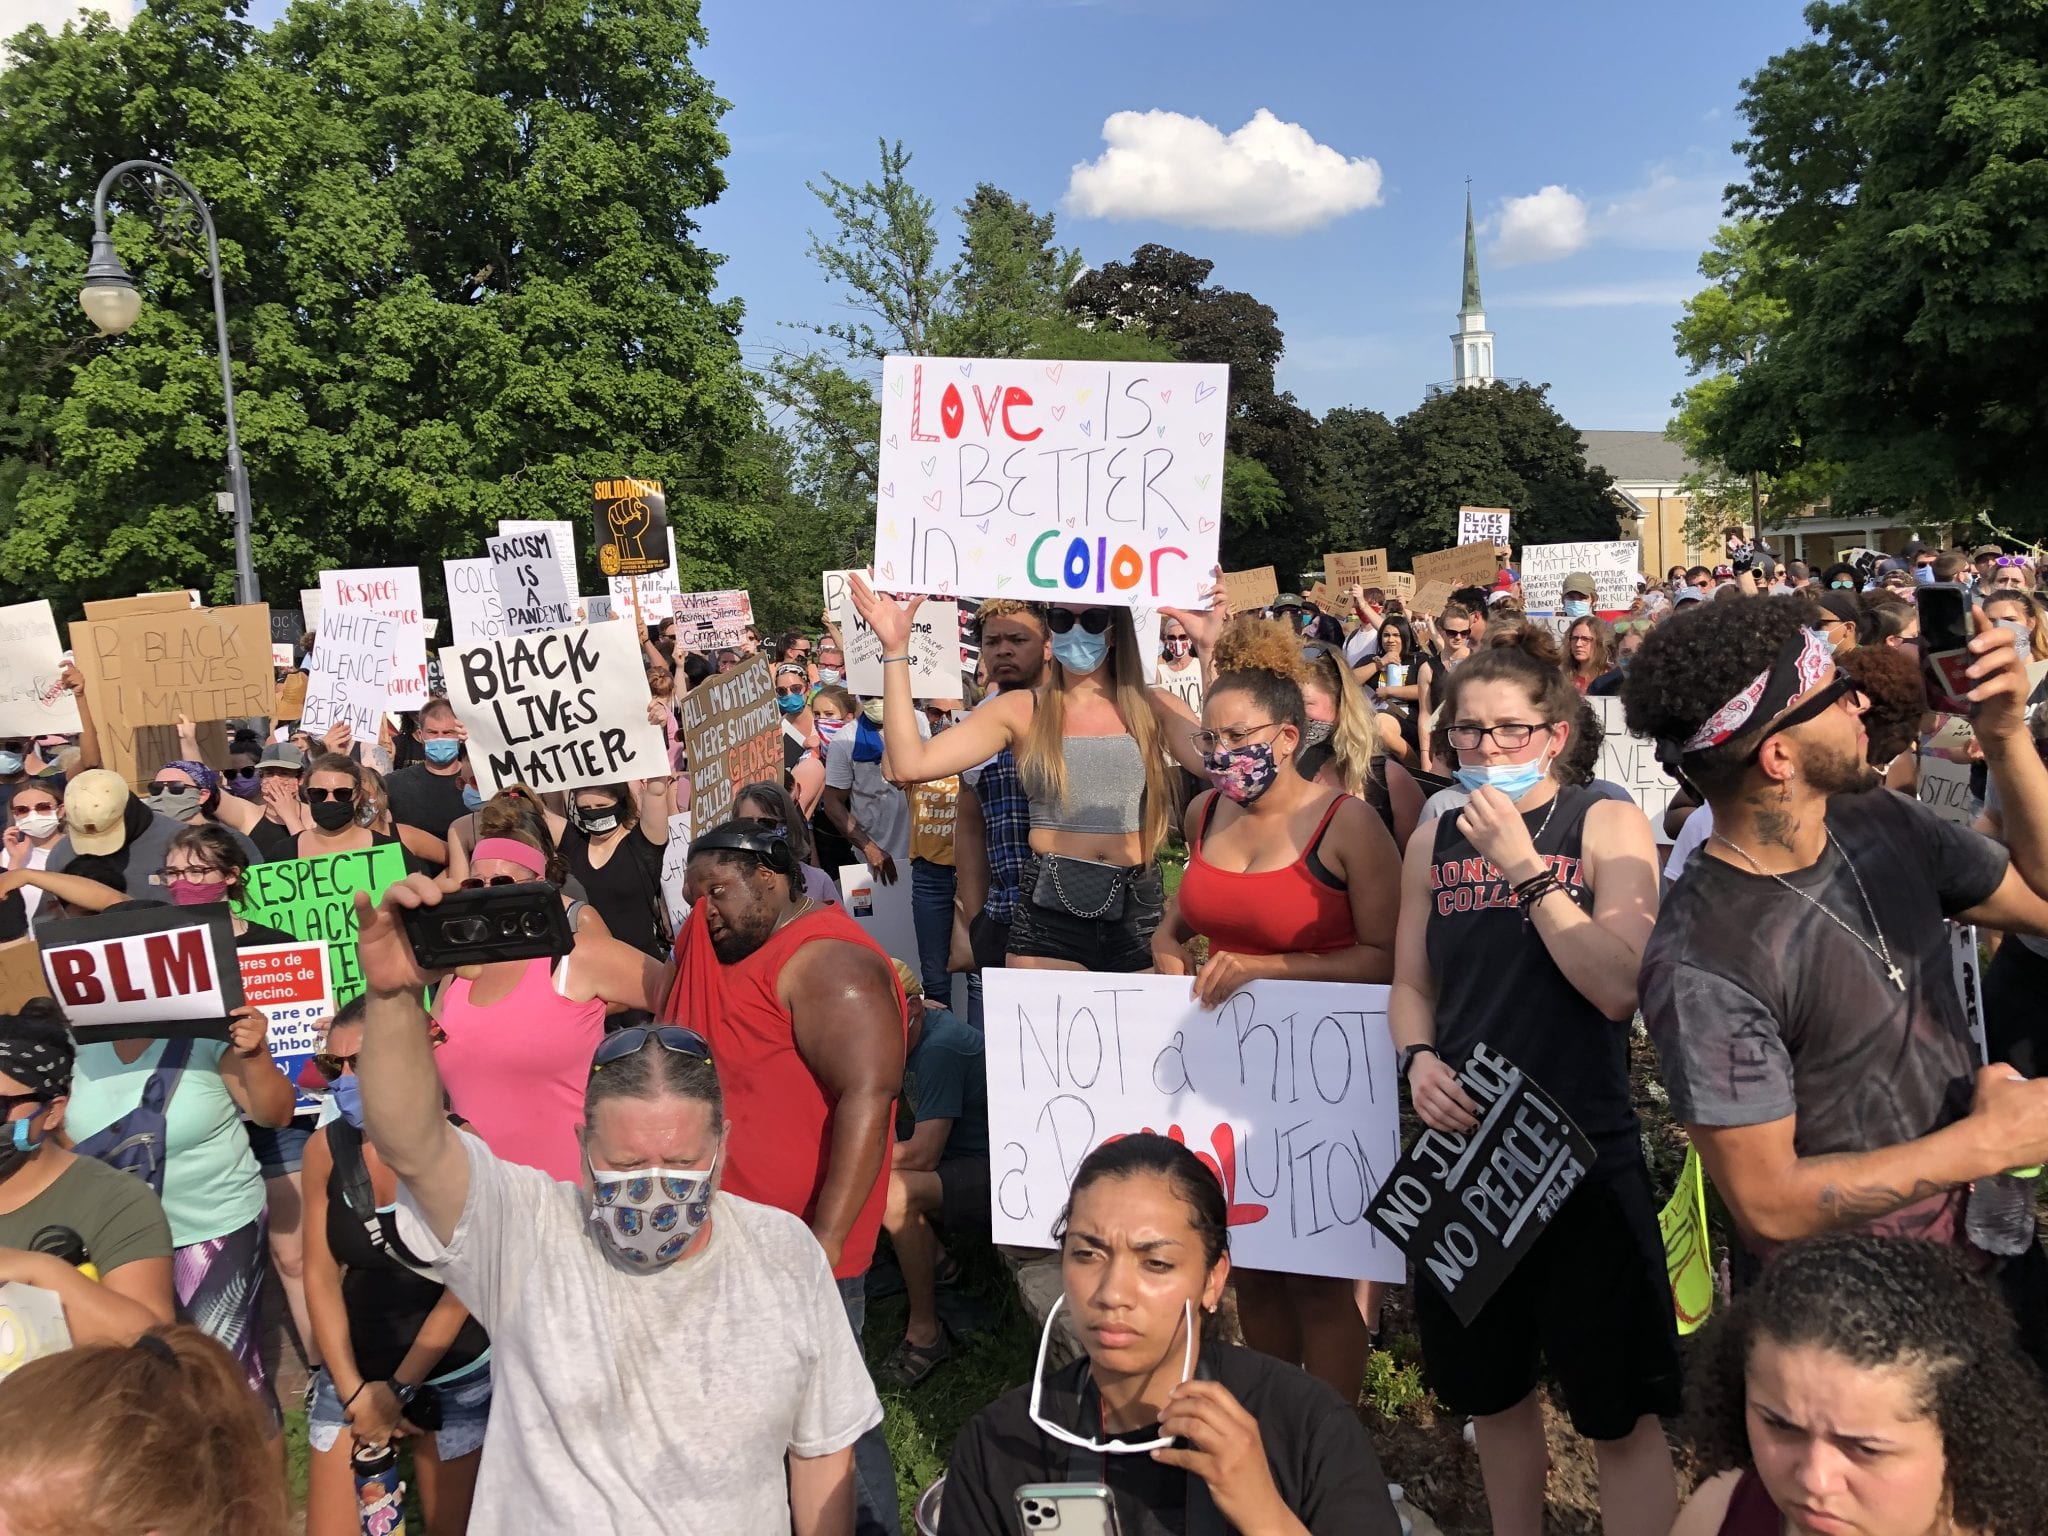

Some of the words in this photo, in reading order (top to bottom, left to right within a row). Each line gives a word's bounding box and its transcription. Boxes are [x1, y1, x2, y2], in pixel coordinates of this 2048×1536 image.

[1104, 370, 1152, 441] IS
[595, 480, 662, 500] SOLIDARITY!
[959, 443, 1190, 531] BETTER
[1463, 524, 1502, 535] LIVES
[1464, 512, 1502, 524] BLACK
[492, 533, 552, 564] RACISM
[1522, 545, 1558, 560] BLACK
[1562, 543, 1601, 557] LIVES
[516, 565, 539, 587] IS
[642, 581, 653, 592] All
[337, 579, 399, 608] Respect
[482, 598, 502, 618] IS
[527, 587, 540, 607] A
[681, 594, 719, 608] White
[272, 612, 299, 628] ack
[323, 608, 391, 648] WHITE
[472, 619, 507, 637] NOT
[507, 603, 571, 626] PANDEMIC
[144, 624, 240, 662] BLACK
[684, 629, 740, 645] Complicity
[154, 657, 244, 688] LIVES
[311, 646, 389, 687] SILENCE
[460, 629, 600, 705] BLACK
[142, 673, 271, 726] MATTER!
[331, 682, 348, 702] IS
[683, 698, 707, 732] ALL
[709, 658, 772, 713] MOTHERS
[303, 695, 377, 735] BETRAYAL
[493, 688, 598, 746] LIVES
[488, 728, 636, 790] MATTER
[691, 723, 727, 764] WERE
[694, 758, 722, 792] WHEN
[728, 728, 784, 781] GEORGE
[696, 779, 732, 824] CALLED
[919, 803, 958, 819] kind
[917, 822, 956, 837] peopl
[240, 850, 384, 911] RESPECT
[1437, 884, 1519, 916] COLL
[49, 929, 213, 1007] BLM
[271, 958, 280, 968] o
[285, 953, 302, 966] de
[242, 972, 294, 987] gramos
[298, 968, 315, 981] de
[246, 986, 298, 1000] vecino.
[272, 1008, 300, 1021] are
[305, 1006, 324, 1018] or
[1017, 989, 1144, 1095] NOT
[1152, 1030, 1196, 1095] a
[1216, 991, 1387, 1105] RIOT
[1377, 1175, 1432, 1242] NO
[1412, 1042, 1520, 1180] JUICE
[998, 1141, 1034, 1221] a
[1036, 1094, 1396, 1248] RLUTION
[1425, 1221, 1479, 1293] NO
[1461, 1091, 1570, 1237] PEACE!
[1536, 1156, 1586, 1223] #BLM
